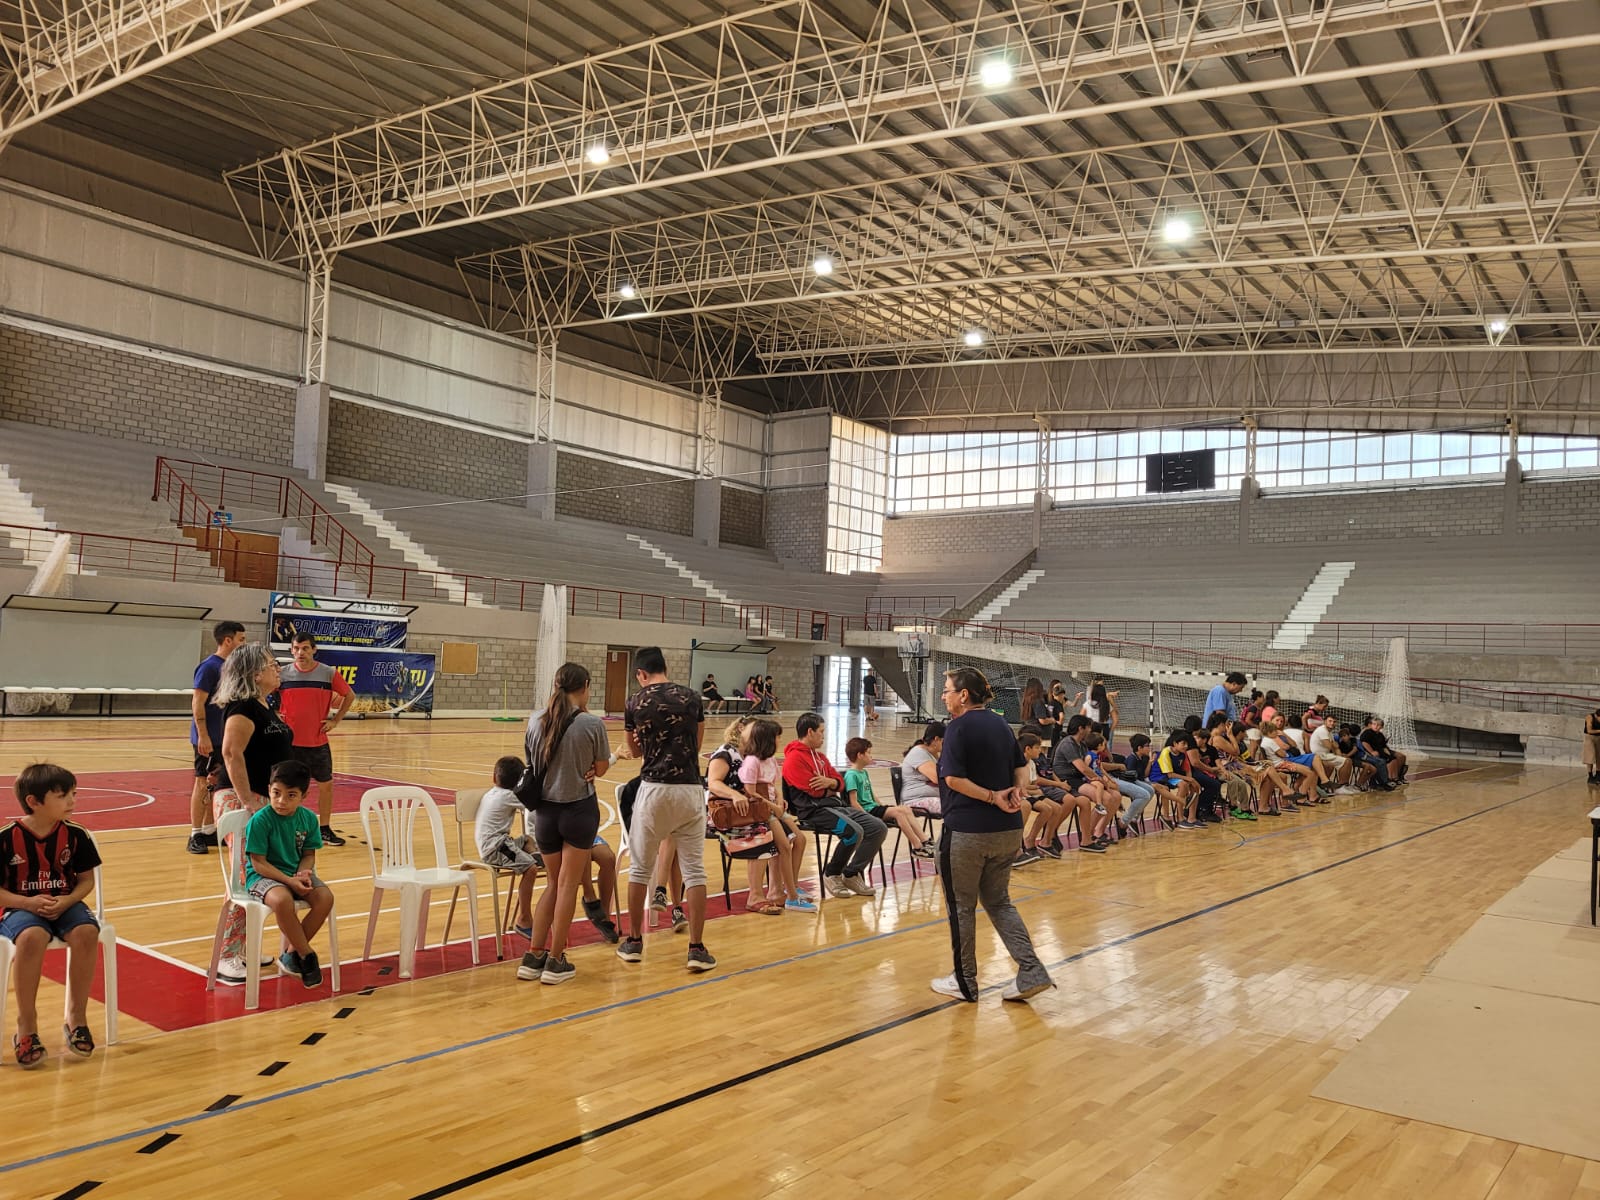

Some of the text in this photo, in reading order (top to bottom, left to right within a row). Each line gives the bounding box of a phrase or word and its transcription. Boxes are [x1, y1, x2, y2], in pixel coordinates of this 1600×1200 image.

[293, 618, 391, 639] POLIDEPORTIO
[372, 661, 399, 677] ERES
[38, 871, 51, 880] Fly
[21, 878, 67, 891] Emirates
